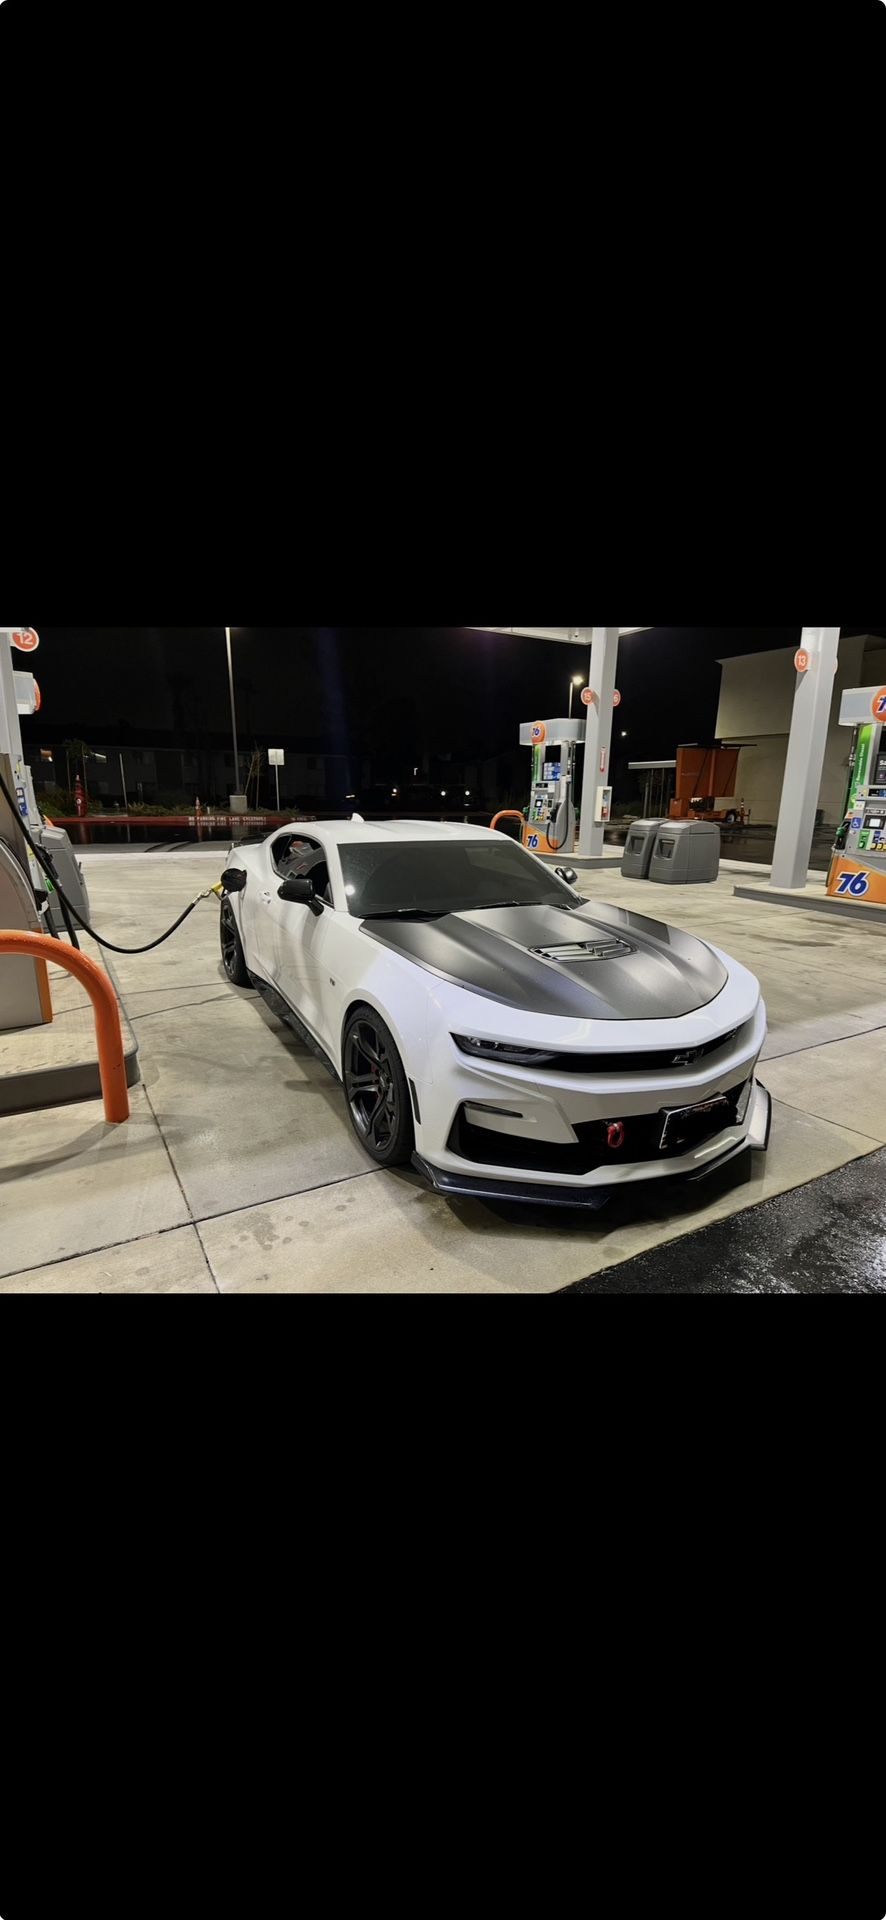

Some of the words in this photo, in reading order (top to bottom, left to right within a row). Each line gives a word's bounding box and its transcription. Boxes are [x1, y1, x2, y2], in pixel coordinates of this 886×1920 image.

[16, 632, 34, 645] 12
[797, 655, 806, 666] 13
[531, 727, 540, 736] 76
[527, 834, 538, 847] 76
[836, 871, 868, 896] 76
